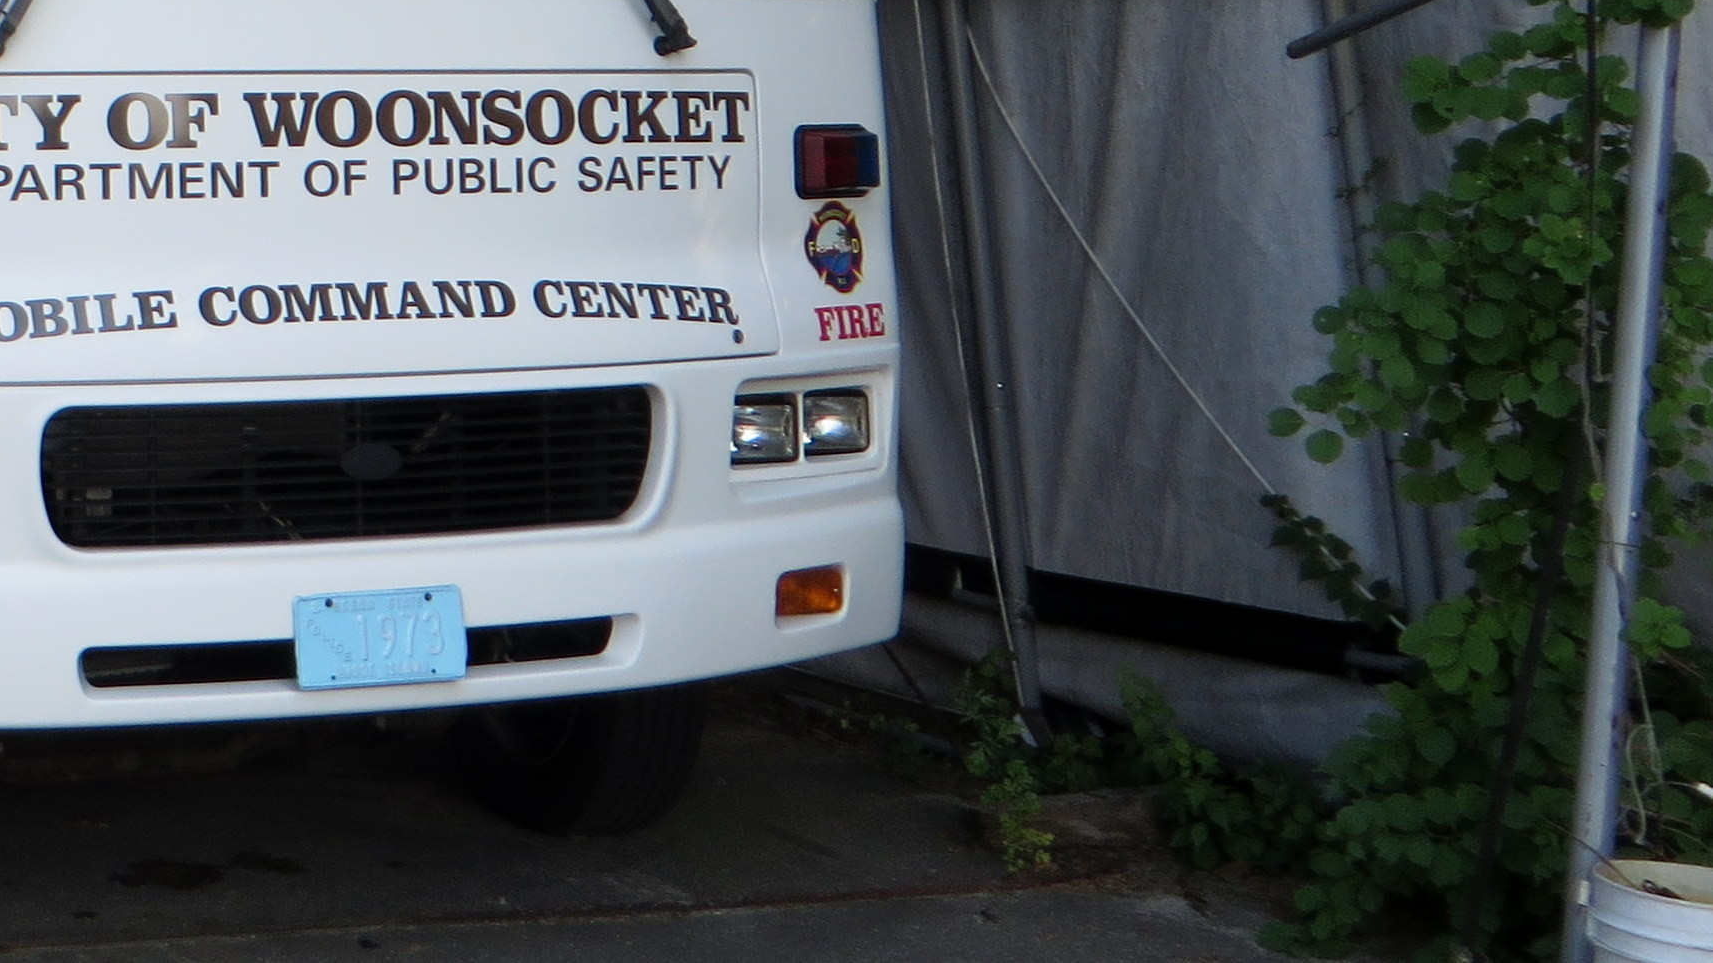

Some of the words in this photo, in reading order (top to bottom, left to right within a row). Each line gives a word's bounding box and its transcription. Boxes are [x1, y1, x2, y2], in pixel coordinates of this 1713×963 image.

[107, 92, 219, 151] OF
[243, 89, 750, 148] WOONSOCKET
[304, 159, 368, 197] OF
[392, 156, 557, 196] PUBLIC
[577, 155, 731, 193] SAFETY
[198, 280, 516, 327] COMMAND
[533, 279, 740, 326] CENTER
[814, 303, 885, 341] FIRE
[355, 610, 446, 662] 1973
